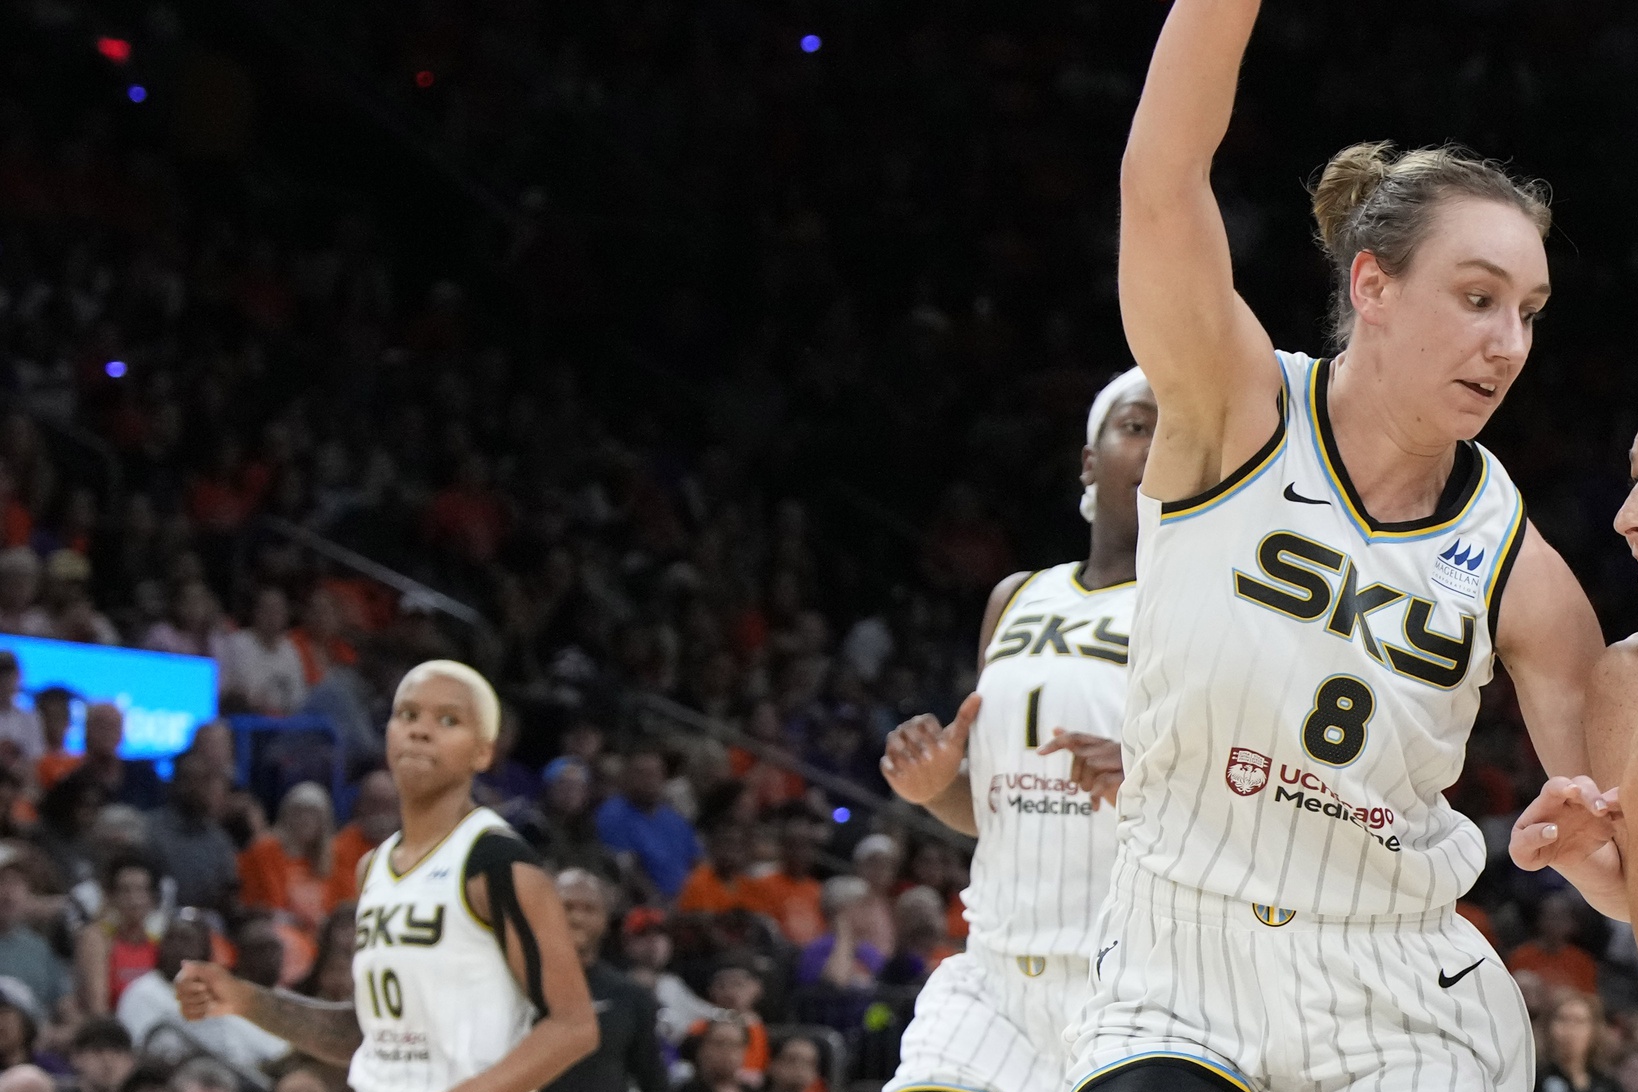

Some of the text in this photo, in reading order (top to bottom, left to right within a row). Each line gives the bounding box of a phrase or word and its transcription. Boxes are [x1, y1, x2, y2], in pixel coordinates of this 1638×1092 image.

[1435, 561, 1480, 587] MAGELLAN
[985, 614, 1131, 667] SKY
[1232, 529, 1477, 692] SKY
[1025, 682, 1046, 750] 1
[1300, 672, 1377, 769] 8
[1007, 794, 1093, 817] Medcine
[1274, 785, 1401, 852] Medicne
[1280, 764, 1395, 830] UChago
[366, 967, 404, 1020] 10
